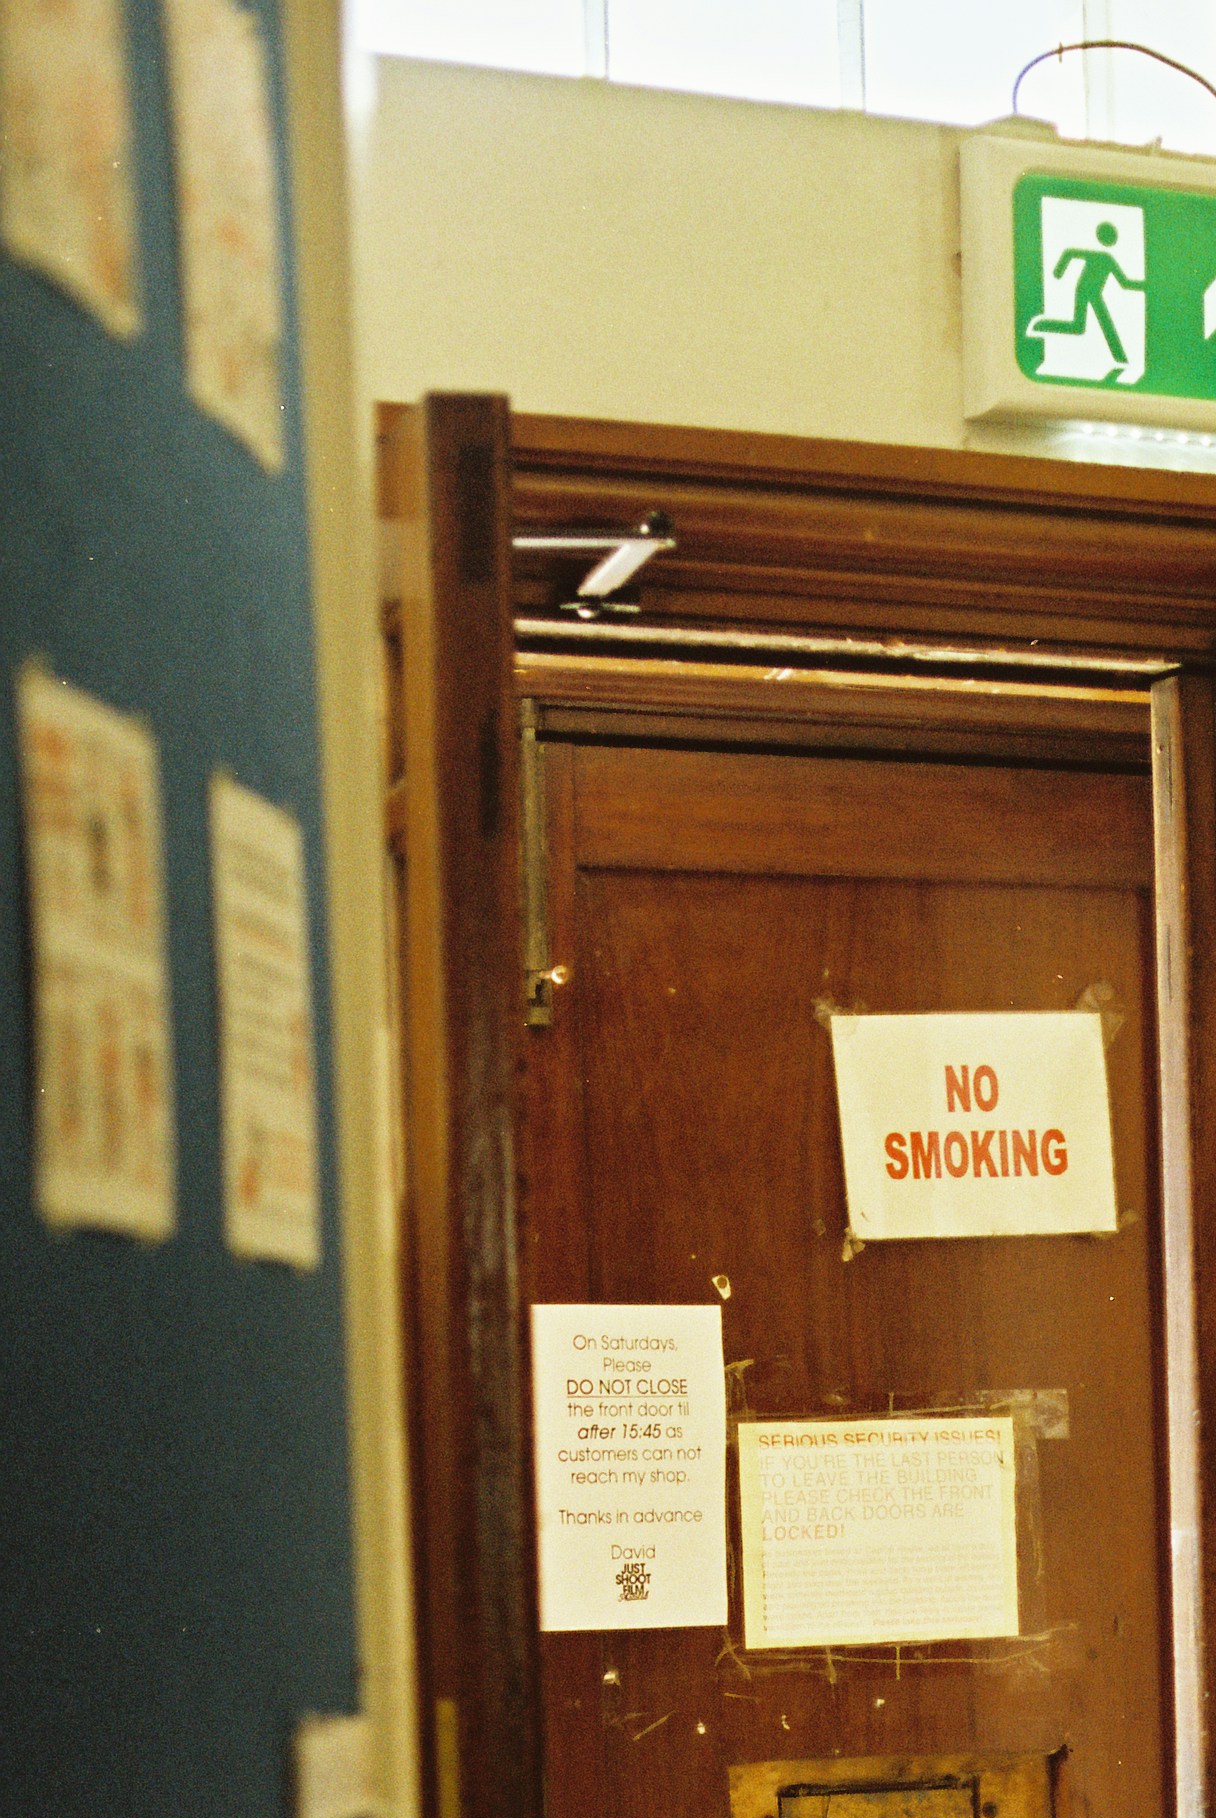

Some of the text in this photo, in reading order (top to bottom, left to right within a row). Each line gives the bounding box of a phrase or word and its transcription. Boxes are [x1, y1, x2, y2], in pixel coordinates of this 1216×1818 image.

[944, 1064, 999, 1113] NO
[884, 1128, 1069, 1180] SMOKING
[572, 1334, 678, 1353] On Saturdays,
[602, 1356, 652, 1373] Please
[566, 1378, 688, 1396] DO NOT CLOSE
[567, 1401, 690, 1418] the front door til
[577, 1423, 684, 1440] after 15:45 as
[758, 1433, 838, 1449] SERIOUS
[843, 1431, 929, 1447] SECURITY
[557, 1446, 702, 1462] customers can not
[853, 1453, 886, 1468] THE
[892, 1451, 930, 1467] LAST
[937, 1449, 1004, 1465] PERSON
[570, 1468, 690, 1486] reach my shop.
[760, 1468, 977, 1488] TO LEAVE THE BUILDING
[762, 1483, 993, 1505] PLEASE CHECK THE FRONT
[558, 1508, 703, 1525] Thanks in advance
[761, 1502, 965, 1524] AND BACK DOORS ARE
[761, 1523, 846, 1541] LOCKED!
[611, 1544, 656, 1560] David
[621, 1563, 645, 1574] JUST
[615, 1573, 651, 1585] SHOOT
[623, 1584, 645, 1596] FILM
